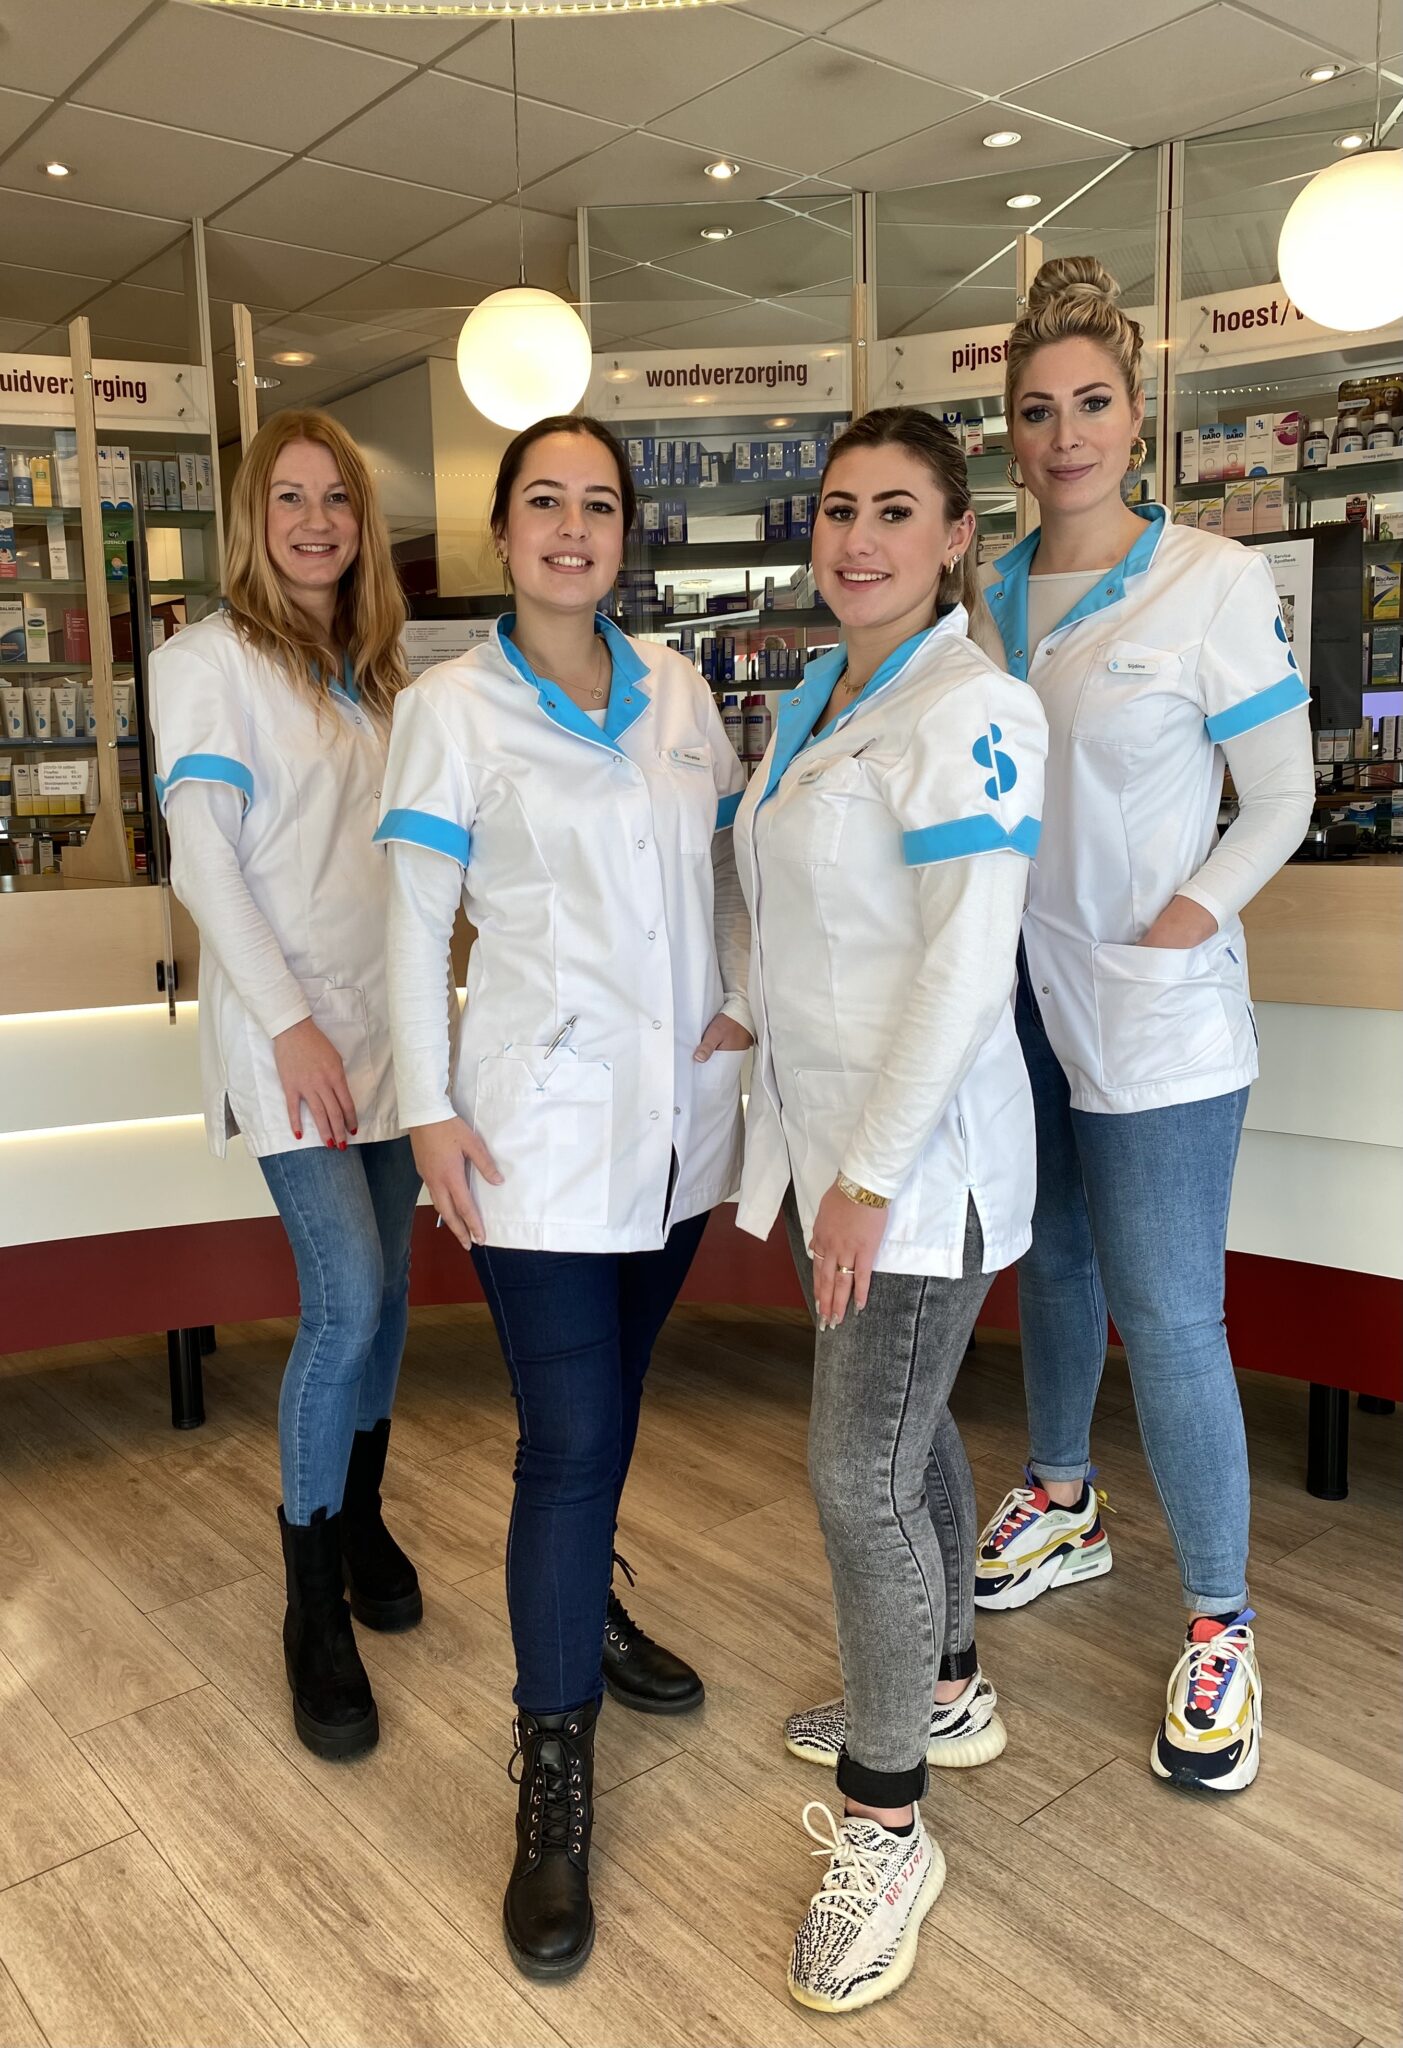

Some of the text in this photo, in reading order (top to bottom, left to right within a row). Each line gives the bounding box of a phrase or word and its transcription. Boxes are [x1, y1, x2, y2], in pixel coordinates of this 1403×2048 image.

[646, 360, 808, 388] wondverzorging
[0, 369, 148, 404] uidverrging
[1202, 432, 1221, 440] DARO
[1226, 432, 1243, 440] DARO
